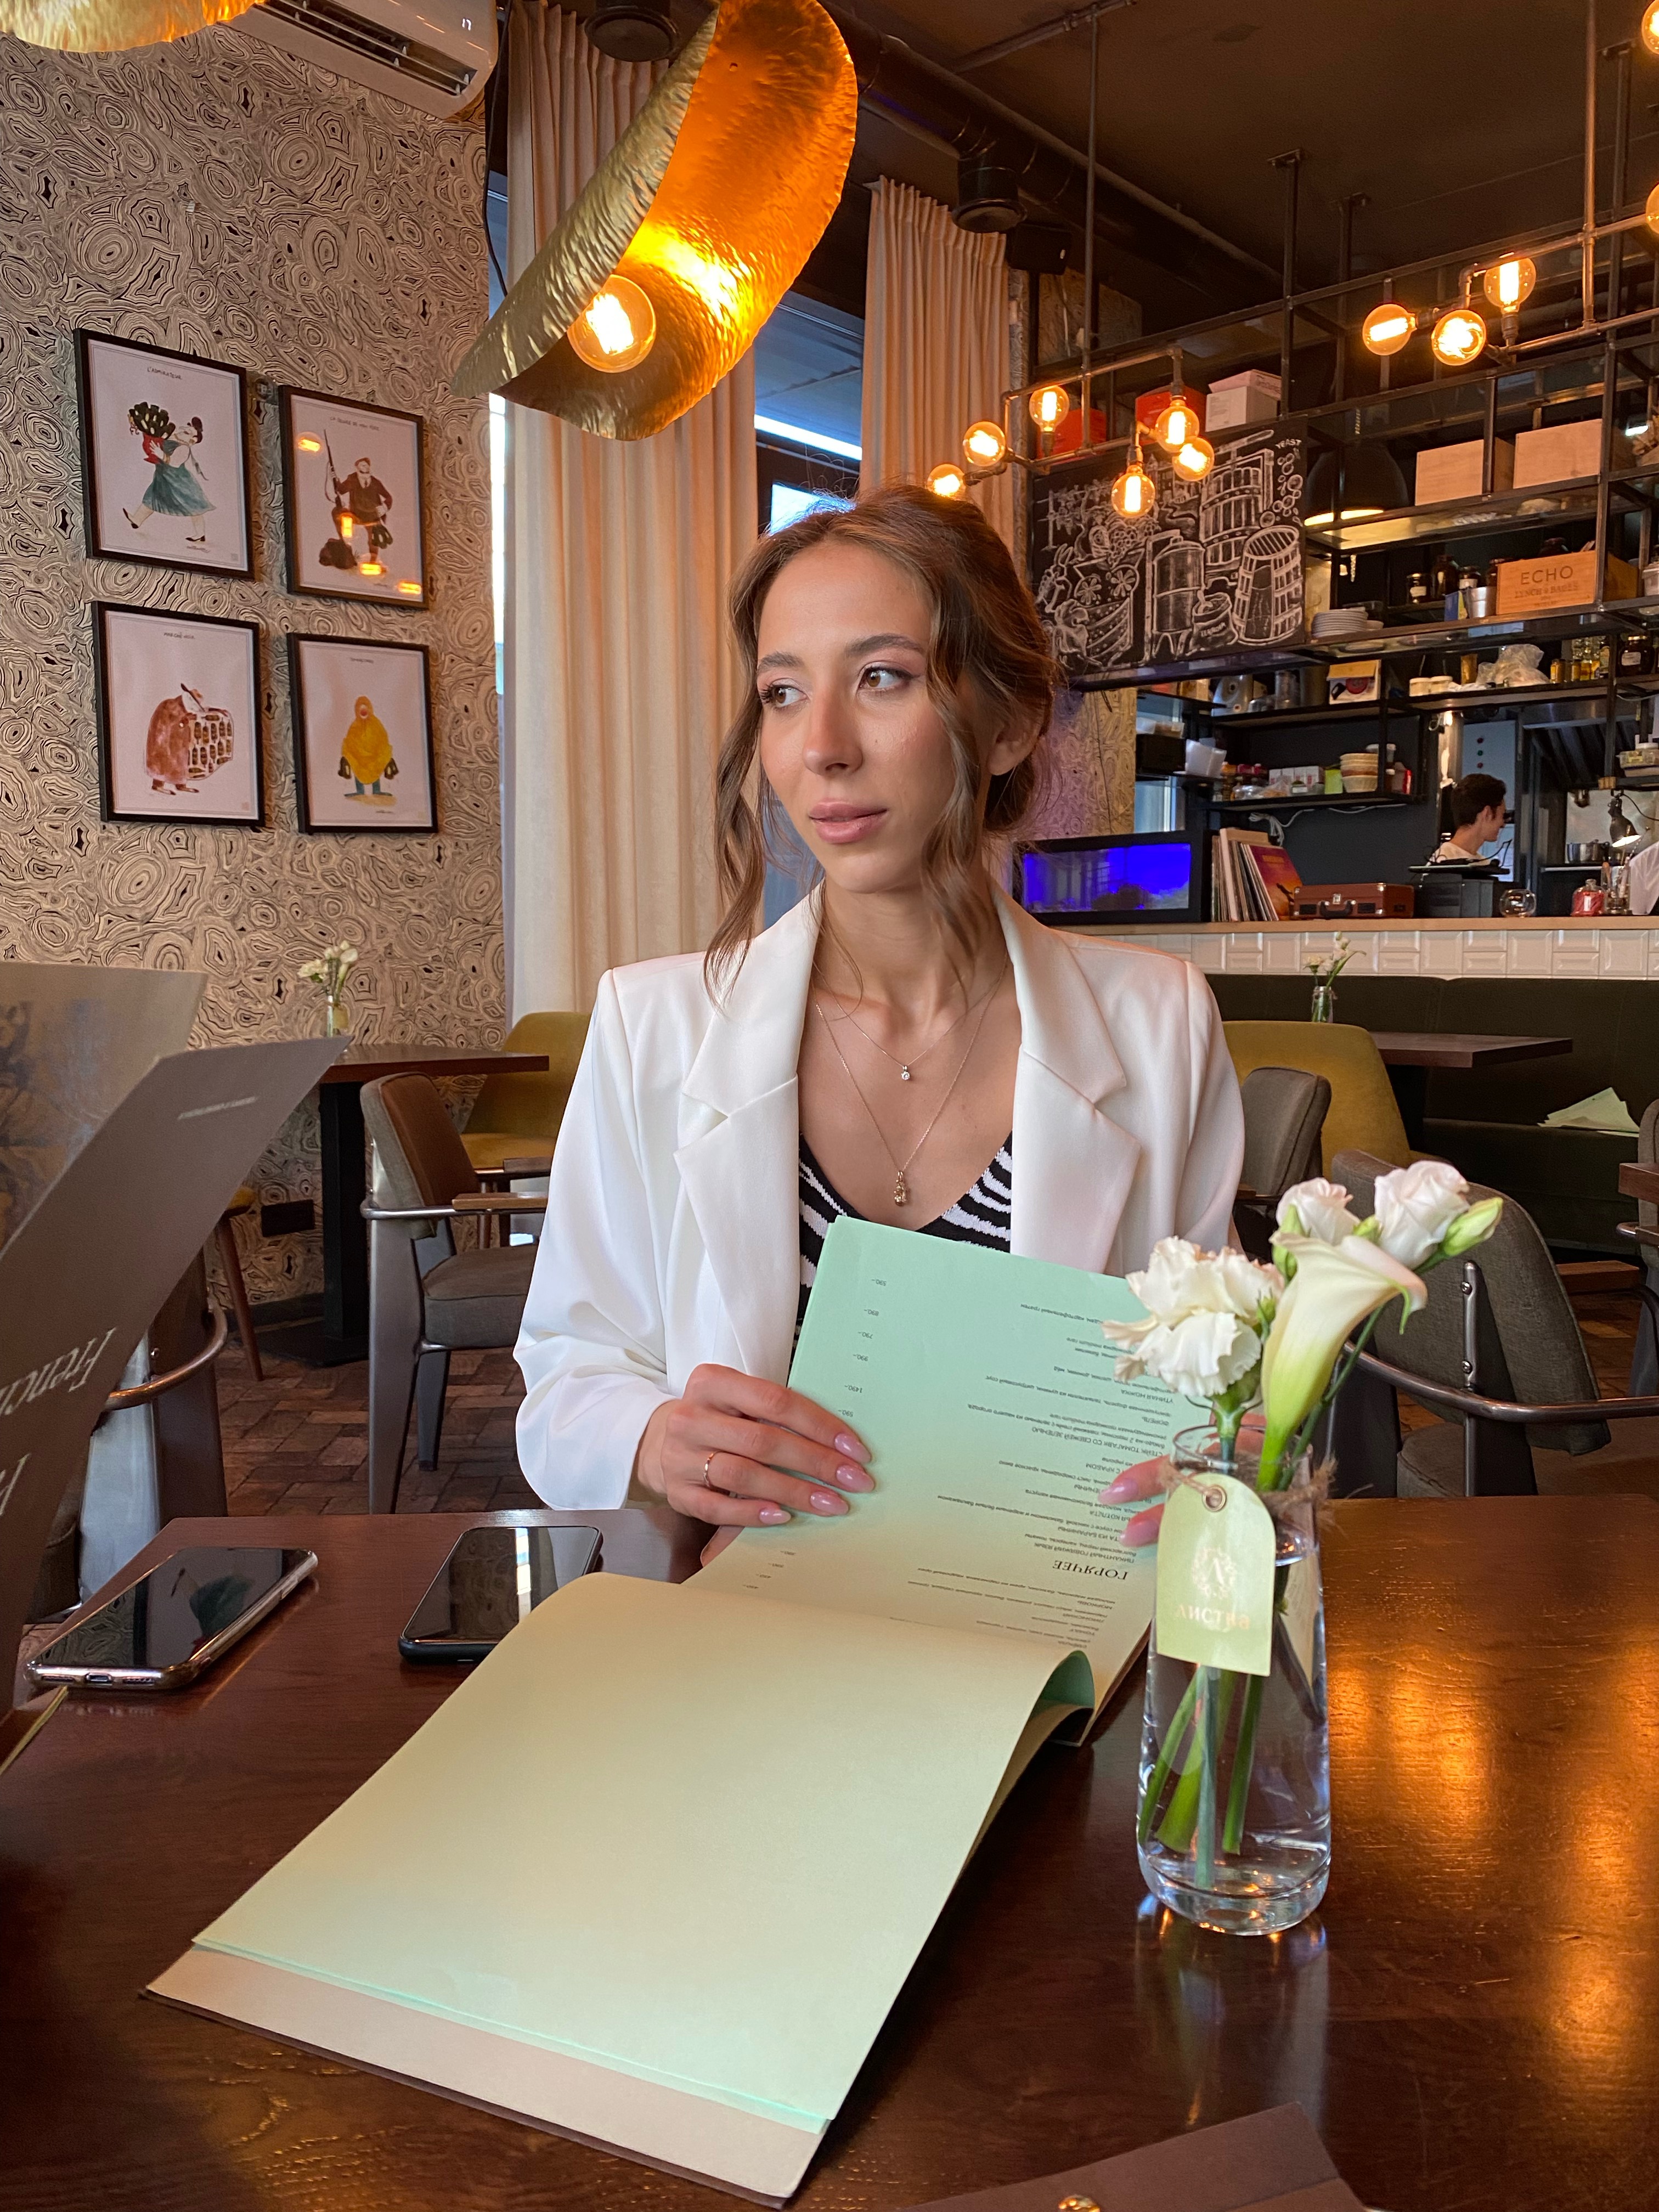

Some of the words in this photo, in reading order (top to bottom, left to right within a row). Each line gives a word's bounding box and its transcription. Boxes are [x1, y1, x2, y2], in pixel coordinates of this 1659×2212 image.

[1275, 438, 1302, 449] YEAST
[1521, 566, 1573, 585] ECHO
[1121, 1389, 1145, 1398] НОЖКА
[1147, 1395, 1172, 1403] УТИНАЯ
[1142, 1417, 1169, 1425] ФОРЕЛЬ
[1031, 1427, 1063, 1437] ЗЕЛЕНЬЮ
[1064, 1434, 1091, 1443] СВЕЖЕЙ
[1104, 1441, 1138, 1453] ТОМАГАВК
[1141, 1449, 1163, 1459] СТЕЙК
[1086, 1463, 1114, 1471] КРАБОМ
[1090, 1511, 1120, 1520] КОТЛЕТА
[1058, 1526, 1097, 1537] БАРАНИНЫ
[1053, 1547, 1088, 1555] ГОВЯЖИЙ
[1100, 1547, 1136, 1556] болгарский
[1090, 1553, 1134, 1563] ПИКАНТНЫЙ
[1053, 1561, 1127, 1579] ГОРЯЧЕЕ
[1077, 1600, 1112, 1609] МОРКОВЬ
